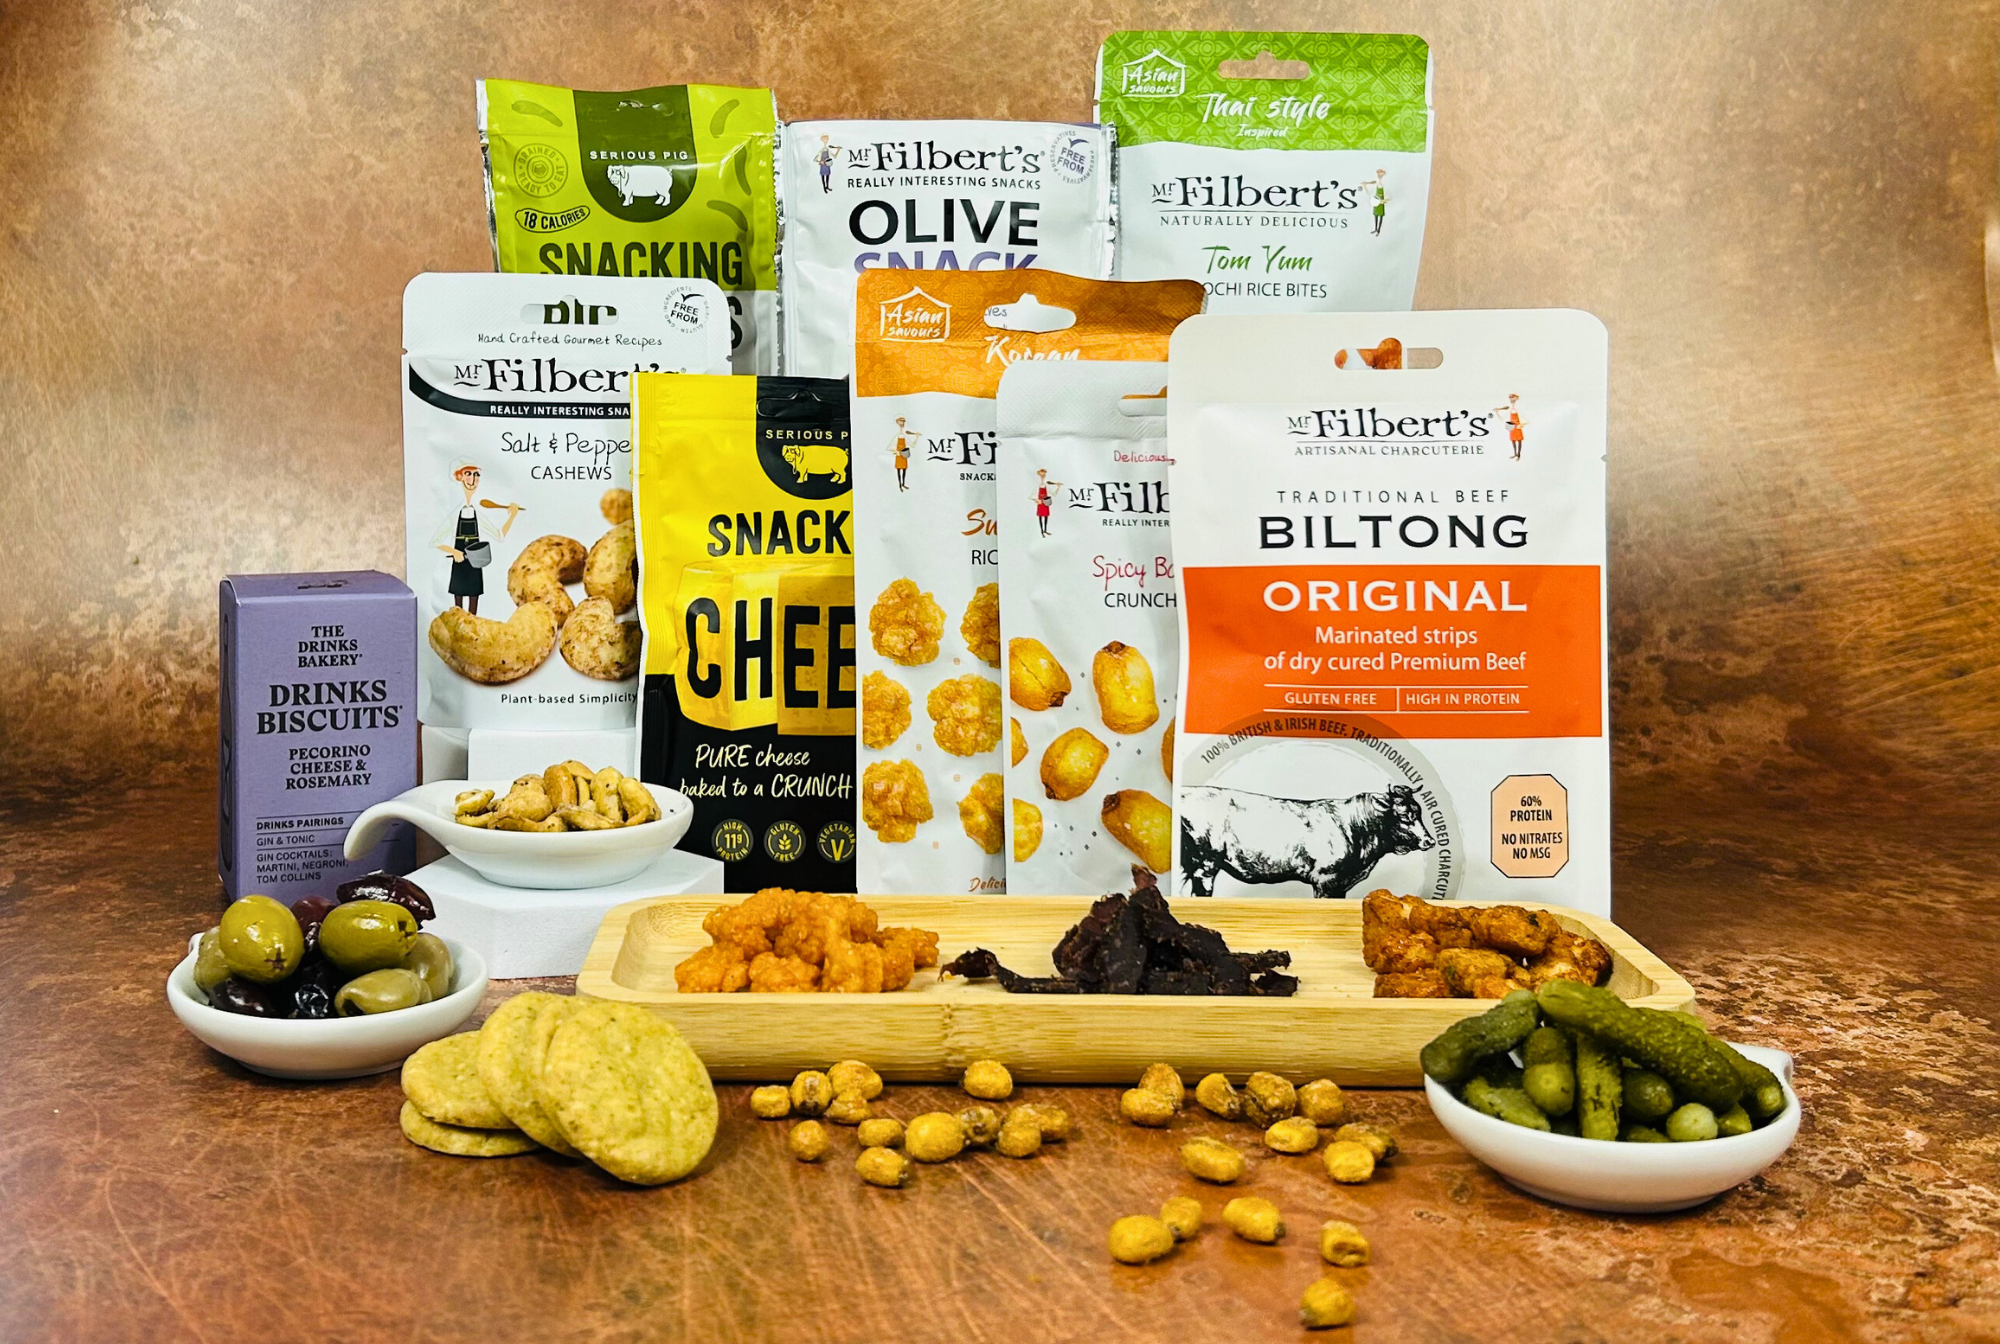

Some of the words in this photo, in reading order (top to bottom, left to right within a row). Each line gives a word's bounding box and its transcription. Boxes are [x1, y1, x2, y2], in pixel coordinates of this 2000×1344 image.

[1128, 64, 1179, 85] Asian
[1128, 83, 1177, 95] savours
[1193, 93, 1257, 123] Thai
[1266, 93, 1331, 128] style
[1236, 123, 1288, 140] Inspired
[518, 147, 557, 164] DRAINED
[590, 151, 655, 160] SERIOUS
[663, 151, 688, 160] PIG
[870, 140, 1041, 174] Filbert's
[1061, 147, 1085, 165] FREE
[1057, 156, 1084, 174] FROM
[518, 172, 542, 194] READY
[544, 182, 557, 193] TO
[554, 165, 565, 183] EAT
[847, 177, 895, 188] REALLY
[900, 176, 986, 187] INTERESTING
[991, 178, 1041, 189] SNACKS
[1175, 175, 1358, 210] Filbert's
[524, 211, 538, 229] 18
[541, 208, 586, 229] CALORIES
[849, 199, 1040, 246] OLIVE
[1160, 216, 1254, 227] NATURALLY
[1260, 216, 1348, 228] DELICIOUS
[539, 242, 743, 286] SNACKING
[1201, 245, 1252, 274] Tom
[1261, 245, 1313, 274] Yum
[1247, 282, 1281, 297] RICE
[1286, 283, 1328, 298] BITES
[674, 302, 699, 316] FREE
[886, 303, 943, 325] Asian
[671, 310, 698, 325] FROM
[887, 326, 941, 338] savours
[478, 333, 505, 343] Hand
[509, 331, 560, 344] Crafted
[563, 334, 610, 345] Gourmet
[615, 333, 663, 351] Recipes
[490, 405, 530, 414] REALLY
[533, 406, 604, 416] INTERESTING
[1310, 407, 1490, 438] Filbert's
[765, 429, 832, 440] SERIOUS
[501, 431, 541, 453] Salt
[549, 432, 558, 454] &
[1294, 446, 1376, 455] ARTISANAL
[1381, 445, 1484, 456] CHARCUTERIE
[531, 466, 612, 480] CASHEWS
[960, 473, 996, 481] SNACK
[1277, 490, 1440, 504] TRADITIONAL
[1455, 489, 1510, 503] BEEF
[1102, 518, 1138, 527] REALLY
[1258, 514, 1529, 549] BILTONG
[1093, 555, 1147, 591] Spicy
[1263, 580, 1528, 612] ORIGINAL
[311, 625, 344, 638] THE
[1315, 625, 1418, 645] Marinated
[1423, 627, 1478, 649] strips
[298, 639, 358, 653] DRINKS
[298, 654, 360, 668] BAKERY
[1263, 651, 1287, 670] of
[1289, 651, 1323, 675] dry
[1328, 651, 1384, 671] cured
[1390, 652, 1480, 671] Premium
[1486, 651, 1527, 671] Beef
[269, 679, 387, 707] DRINKS
[501, 693, 574, 704] Plant-based
[579, 692, 637, 705] Simplicity
[1284, 692, 1341, 704] GLUTEN
[1344, 693, 1377, 705] FREE
[1406, 693, 1440, 705] HIGH
[1445, 693, 1459, 705] IN
[1464, 693, 1520, 705] PROTEIN
[256, 705, 400, 735] BISCUITS
[289, 744, 371, 760] PECORINO
[695, 743, 752, 769] PURE
[755, 743, 811, 767] cheese
[290, 760, 352, 774] CHEESE
[356, 759, 367, 771] &
[285, 773, 372, 790] ROSEMARY
[680, 775, 727, 798] baked
[732, 777, 748, 796] to
[754, 784, 764, 797] a
[771, 773, 853, 799] CRUNCH
[1200, 739, 1230, 764] 100%
[1228, 721, 1272, 746] BRITISH
[1274, 719, 1283, 731] &
[1285, 717, 1316, 731] IRISH
[1351, 727, 1424, 785] TRADITIONALLY
[1420, 790, 1438, 811] AIR
[1430, 810, 1450, 847] CURED
[1520, 795, 1542, 807] 60%
[1510, 809, 1552, 822] PROTEIN
[256, 820, 294, 830] DRINKS
[297, 817, 344, 828] PAIRINGS
[723, 822, 743, 831] HIGH
[770, 824, 800, 836] GLUTEN
[256, 837, 274, 846] GIN
[276, 836, 283, 845] &
[286, 834, 315, 844] TONIC
[818, 823, 856, 844] VEGETARIAN
[1501, 833, 1517, 845] NO
[1519, 832, 1563, 844] NITRATES
[256, 853, 274, 862] GIN
[276, 849, 333, 861] COCKTAILS:
[717, 847, 748, 862] PROTEIN
[774, 853, 795, 862] FREE
[830, 839, 845, 862] V
[1512, 847, 1528, 859] NO
[1530, 847, 1551, 859] MSG
[256, 863, 300, 873] MARTINI,
[302, 860, 349, 870] NEGRONI,
[256, 875, 278, 884] TOM
[280, 871, 321, 882] COLLINS
